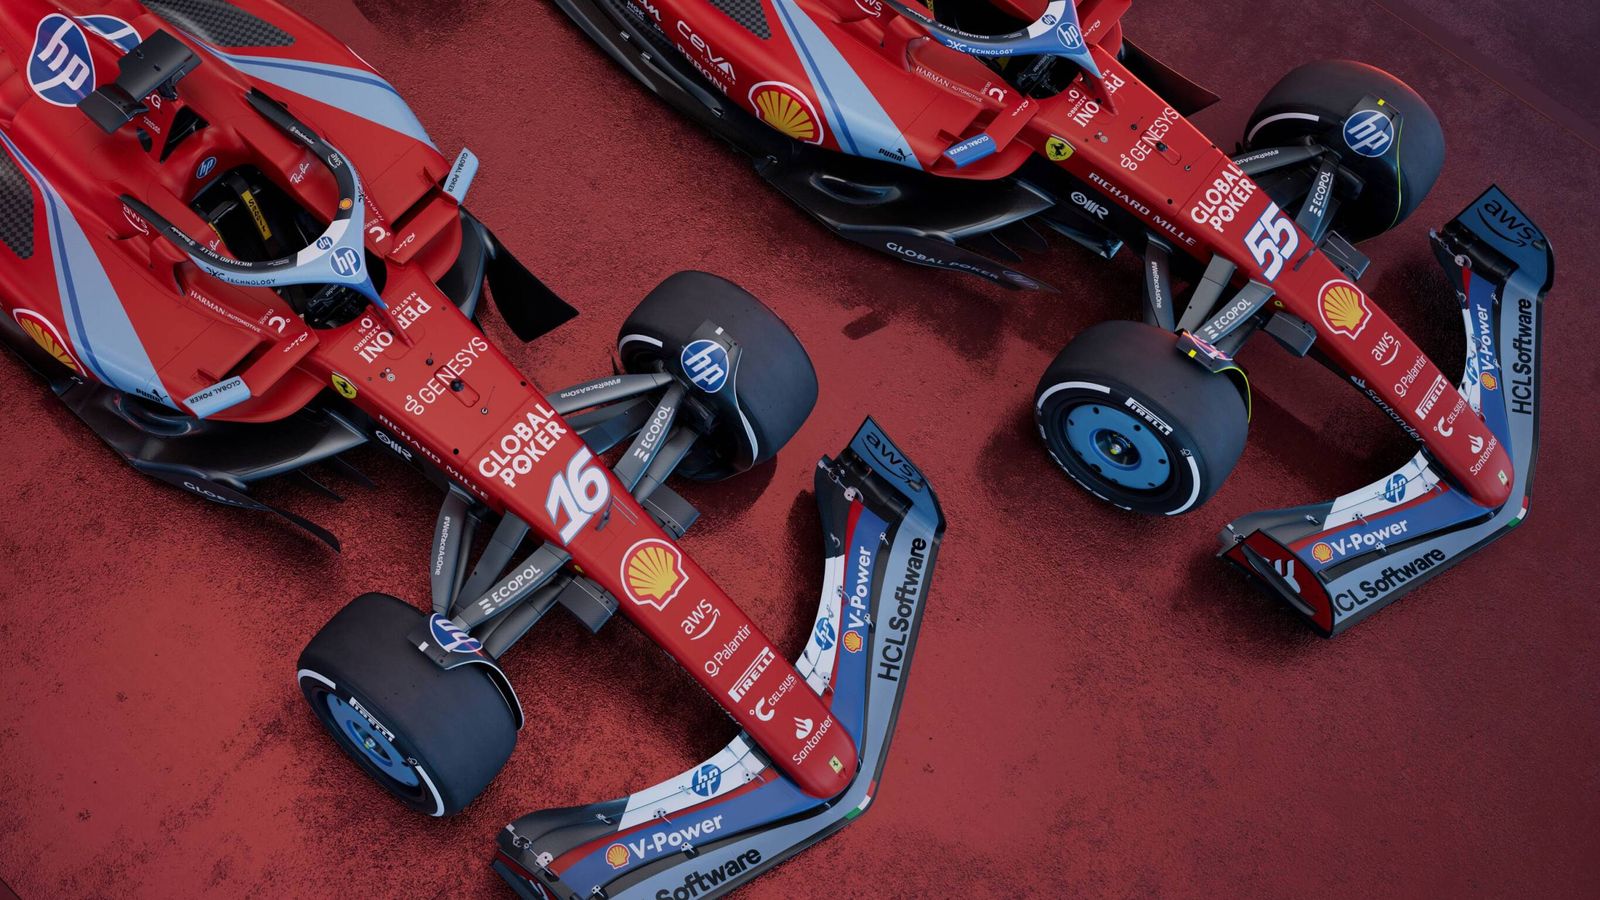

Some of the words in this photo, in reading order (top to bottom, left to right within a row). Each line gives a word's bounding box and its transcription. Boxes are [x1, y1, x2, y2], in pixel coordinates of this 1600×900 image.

[946, 39, 967, 53] DXC
[968, 47, 1014, 55] TECHNOLOGY
[1060, 24, 1081, 48] hp
[32, 17, 92, 98] hp
[915, 65, 949, 88] HARMAN
[1130, 106, 1180, 162] GENESYS
[1346, 110, 1391, 153] hp
[196, 156, 217, 178] hp
[1088, 172, 1150, 216] RICHARD
[1152, 215, 1197, 247] MILLE
[1190, 163, 1243, 224] GLOBAL
[1208, 178, 1257, 233] POKER
[1313, 171, 1331, 207] ECOPOL
[1243, 200, 1299, 283] 55
[1484, 199, 1536, 244] aws
[227, 278, 276, 286] TECHNOLOGY
[333, 248, 357, 276] hp
[885, 242, 945, 265] GLOBAL
[949, 261, 999, 280] POKER
[190, 290, 225, 315] HARMAN
[227, 313, 261, 333] AUTOMOTIVE
[391, 292, 417, 315] NASTRO
[1213, 298, 1252, 330] ECOPOL
[353, 324, 381, 352] AZZURRO
[1371, 331, 1395, 361] aws
[1480, 303, 1495, 371] V-Power
[418, 336, 488, 405] GENESYS
[683, 341, 726, 387] hp
[1400, 354, 1428, 388] Palantir
[189, 391, 213, 404] POKER
[213, 380, 241, 395] GLOBAL
[560, 378, 621, 398] #WeRaceAsOne
[1414, 374, 1448, 420] PIRELLI
[640, 404, 672, 447] ECOPOL
[1125, 397, 1174, 436] PIRELLI
[1365, 389, 1425, 442] Santander
[1446, 398, 1466, 425] CELSIUS
[379, 414, 441, 465] RICHARD
[446, 465, 489, 500] MILLE
[478, 403, 555, 478] GLOBAL
[499, 420, 568, 489] POKER
[865, 431, 914, 477] aws
[1469, 436, 1497, 476] Santander
[545, 444, 611, 547] 16
[1385, 474, 1408, 503] hp
[434, 516, 450, 576] #WeRaceAsOne
[1331, 518, 1408, 556] V-Power
[491, 564, 541, 604] ECOPOL
[847, 546, 872, 629] V-Power
[680, 599, 713, 635] aws
[877, 537, 927, 682] HCLSoftware
[713, 624, 752, 666] Palantir
[815, 617, 835, 650] hp
[728, 646, 776, 703] PIRELLI
[768, 673, 796, 706] CELSIUS
[792, 715, 833, 765] Santander
[694, 766, 721, 796] hp
[629, 814, 723, 860] V-Power
